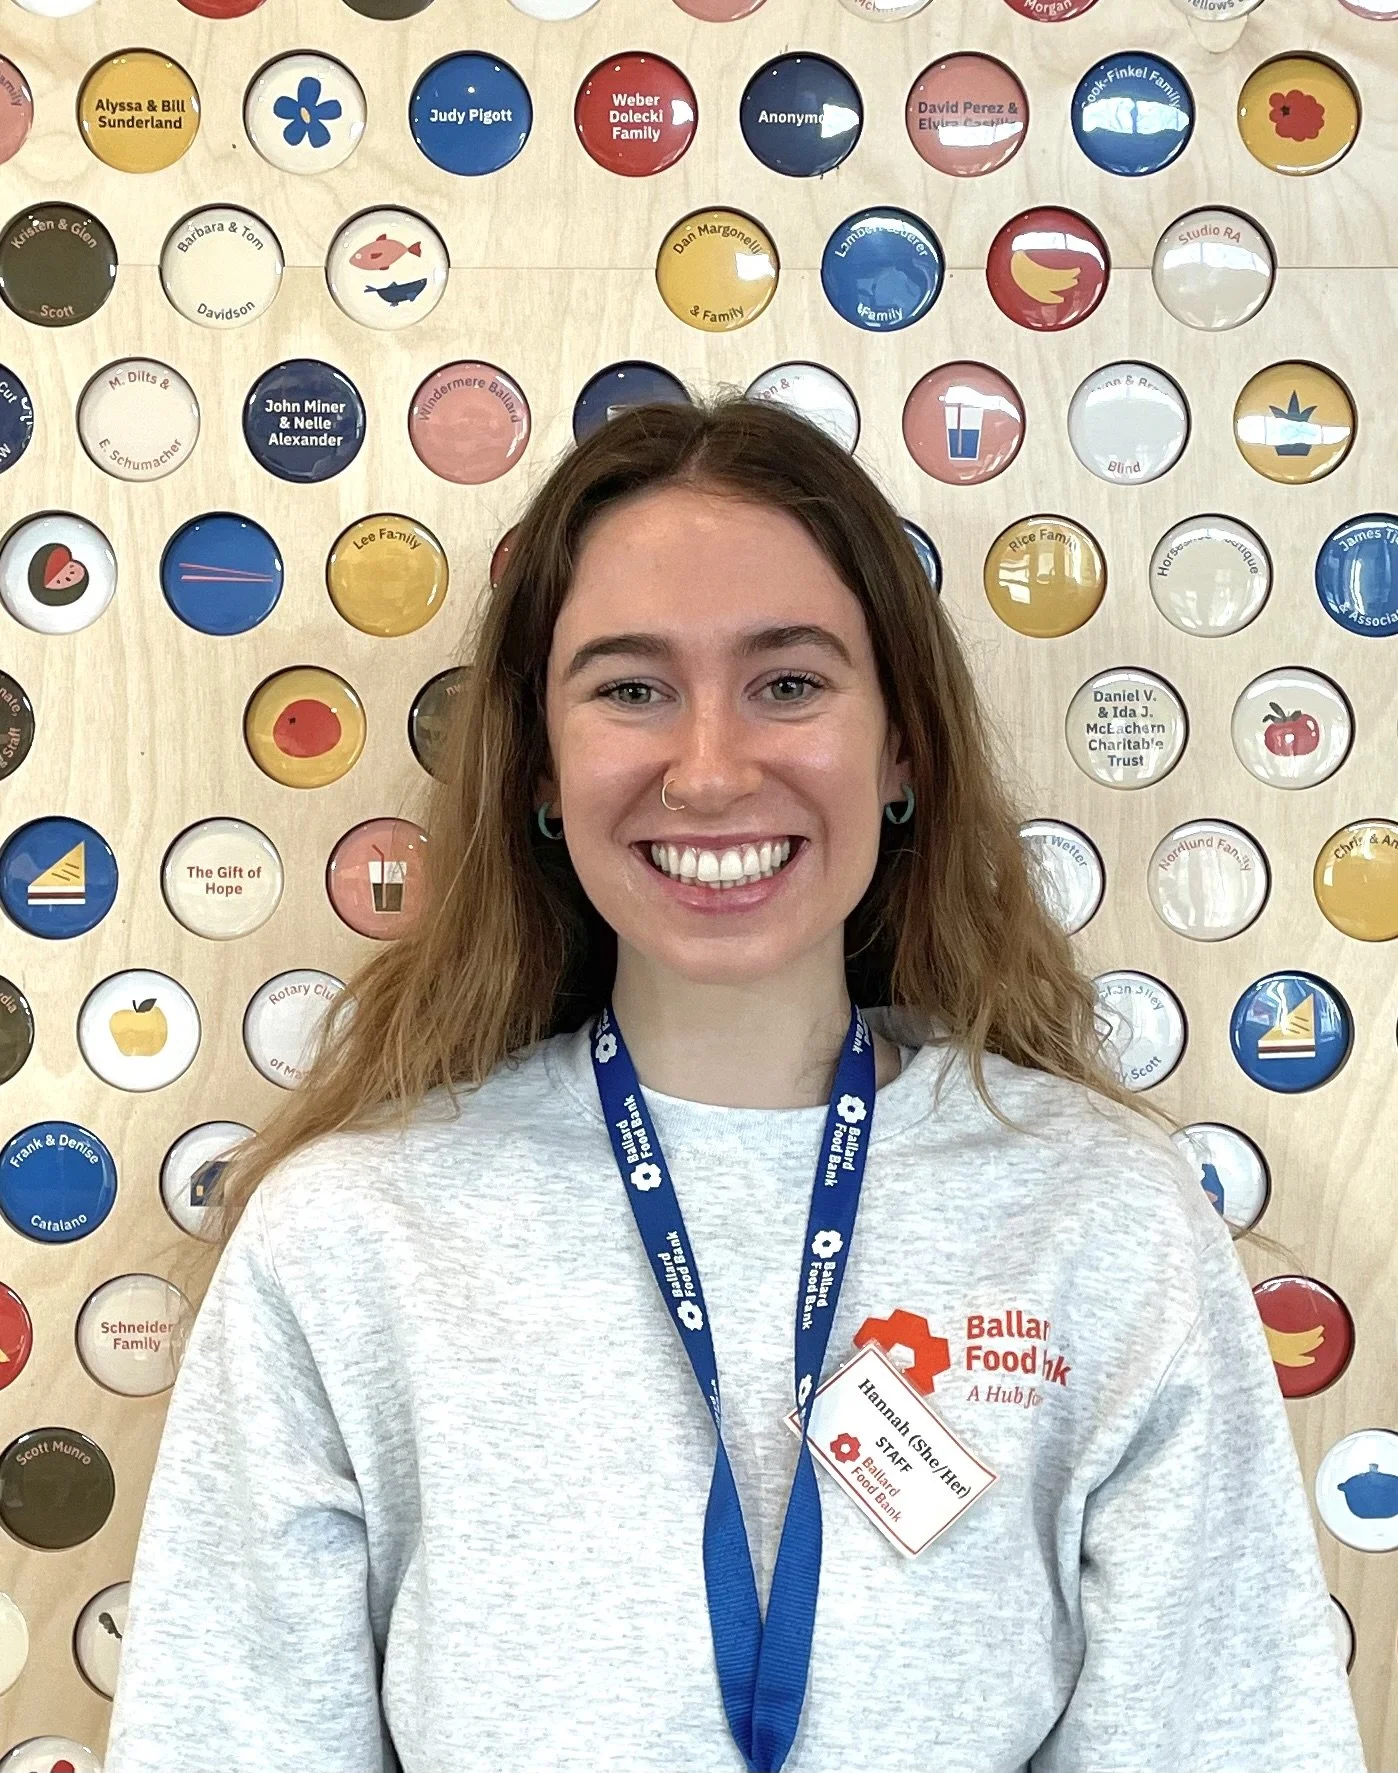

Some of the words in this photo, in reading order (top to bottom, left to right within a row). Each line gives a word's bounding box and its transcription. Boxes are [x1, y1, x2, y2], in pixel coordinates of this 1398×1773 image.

[95, 98, 143, 114] Alyssa
[146, 100, 157, 112] &
[161, 99, 186, 112] Bill
[612, 92, 660, 106] Weber
[918, 101, 958, 114] David
[963, 101, 1004, 114] Perez
[1007, 102, 1018, 114] &
[98, 116, 182, 129] Sunderland
[429, 108, 466, 125] Judy
[469, 108, 512, 125] Pigott
[609, 110, 663, 123] Dolecki
[612, 126, 660, 142] Family
[11, 220, 54, 249] Kristen
[58, 219, 68, 230] &
[71, 223, 98, 249] Glen
[177, 223, 225, 252] Barbara
[228, 222, 238, 233] &
[241, 226, 264, 250] Tom
[673, 233, 697, 254] Dan
[1178, 224, 1221, 245] Studio
[1223, 227, 1241, 243] RA
[40, 304, 75, 318] Scott
[197, 302, 256, 320] Davidson
[690, 305, 700, 318] &
[702, 306, 744, 323] Family
[862, 307, 903, 321] Family
[108, 377, 125, 391] M.
[127, 370, 157, 385] Dilts
[159, 378, 171, 391] &
[264, 399, 300, 413] John
[304, 400, 346, 413] Miner
[419, 377, 486, 421] Windermere
[488, 381, 521, 423] Ballard
[279, 416, 291, 429] &
[294, 416, 332, 430] Nelle
[268, 432, 343, 446] Alexander
[98, 438, 111, 452] E.
[109, 439, 182, 471] Schumacher
[1107, 460, 1141, 474] Blind
[352, 533, 376, 550] Lee
[378, 527, 422, 550] Family
[1008, 533, 1036, 553] Rice
[1338, 529, 1382, 552] James
[1093, 689, 1140, 702] Daniel
[1143, 689, 1157, 702] V.
[1097, 706, 1109, 719] &
[1112, 706, 1137, 718] Ida
[1140, 706, 1154, 718] J.
[1086, 722, 1166, 735] McEachern
[2, 727, 21, 758] Staff
[1088, 738, 1164, 751] Charitable
[1107, 755, 1144, 767] Trust
[1369, 833, 1379, 845] &
[1051, 834, 1088, 868] Wetter
[1159, 836, 1214, 871] Nordlund
[186, 866, 214, 879] The
[217, 866, 244, 879] Gift
[247, 866, 262, 879] of
[205, 882, 243, 897] Hope
[268, 984, 311, 1005] Rotary
[314, 983, 335, 1001] Clu
[270, 1058, 285, 1070] of
[1131, 1056, 1162, 1080] Scott
[623, 1094, 643, 1129] Bank
[616, 1119, 640, 1164] Ballard
[633, 1126, 654, 1160] Food
[831, 1122, 848, 1153] Food
[10, 1138, 43, 1168] Frank
[45, 1134, 56, 1147] &
[59, 1134, 99, 1165] Denise
[843, 1126, 861, 1172] Ballard
[824, 1155, 842, 1188] Bank
[30, 1214, 87, 1232] Catalano
[665, 1230, 686, 1265] Bank
[657, 1251, 684, 1299] Ballard
[677, 1265, 697, 1298] Food
[806, 1261, 823, 1293] Food
[816, 1261, 837, 1308] Ballard
[801, 1295, 817, 1331] Bank
[101, 1321, 173, 1334] Schneider
[113, 1337, 161, 1352] Family
[965, 1344, 1037, 1375] Food
[966, 1384, 980, 1402] A
[985, 1384, 1024, 1405] Hub
[858, 1378, 910, 1438] Hannah
[908, 1434, 972, 1500] (She/Her)
[16, 1441, 49, 1465] Scott
[52, 1441, 92, 1465] Munro
[875, 1436, 913, 1473] STAFF
[861, 1456, 902, 1498] Ballard
[850, 1466, 880, 1495] Food
[874, 1492, 902, 1523] Bank
